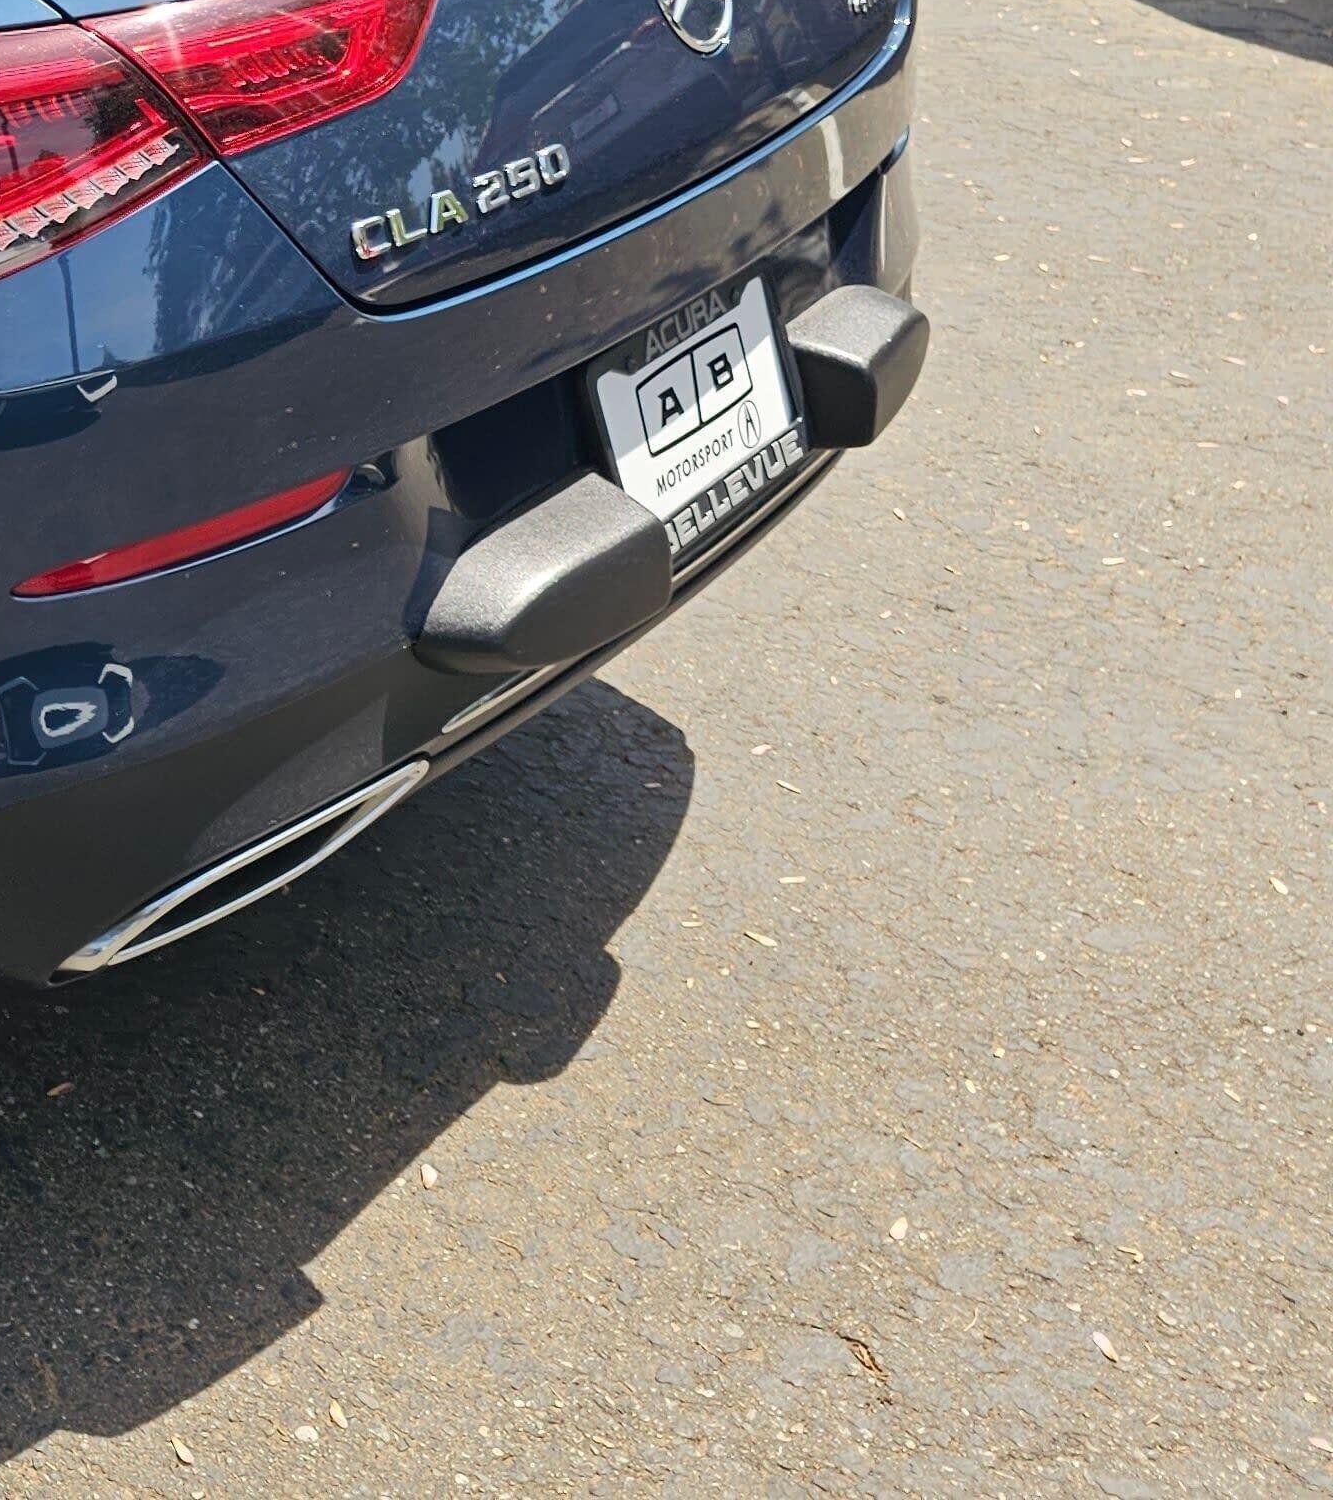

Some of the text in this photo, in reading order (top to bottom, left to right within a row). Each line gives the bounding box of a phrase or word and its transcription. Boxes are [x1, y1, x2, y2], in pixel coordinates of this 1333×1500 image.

[351, 143, 570, 260] CLA 250
[643, 289, 728, 363] ACURA
[658, 352, 735, 429] A B
[655, 428, 734, 498] MOTORSPORT
